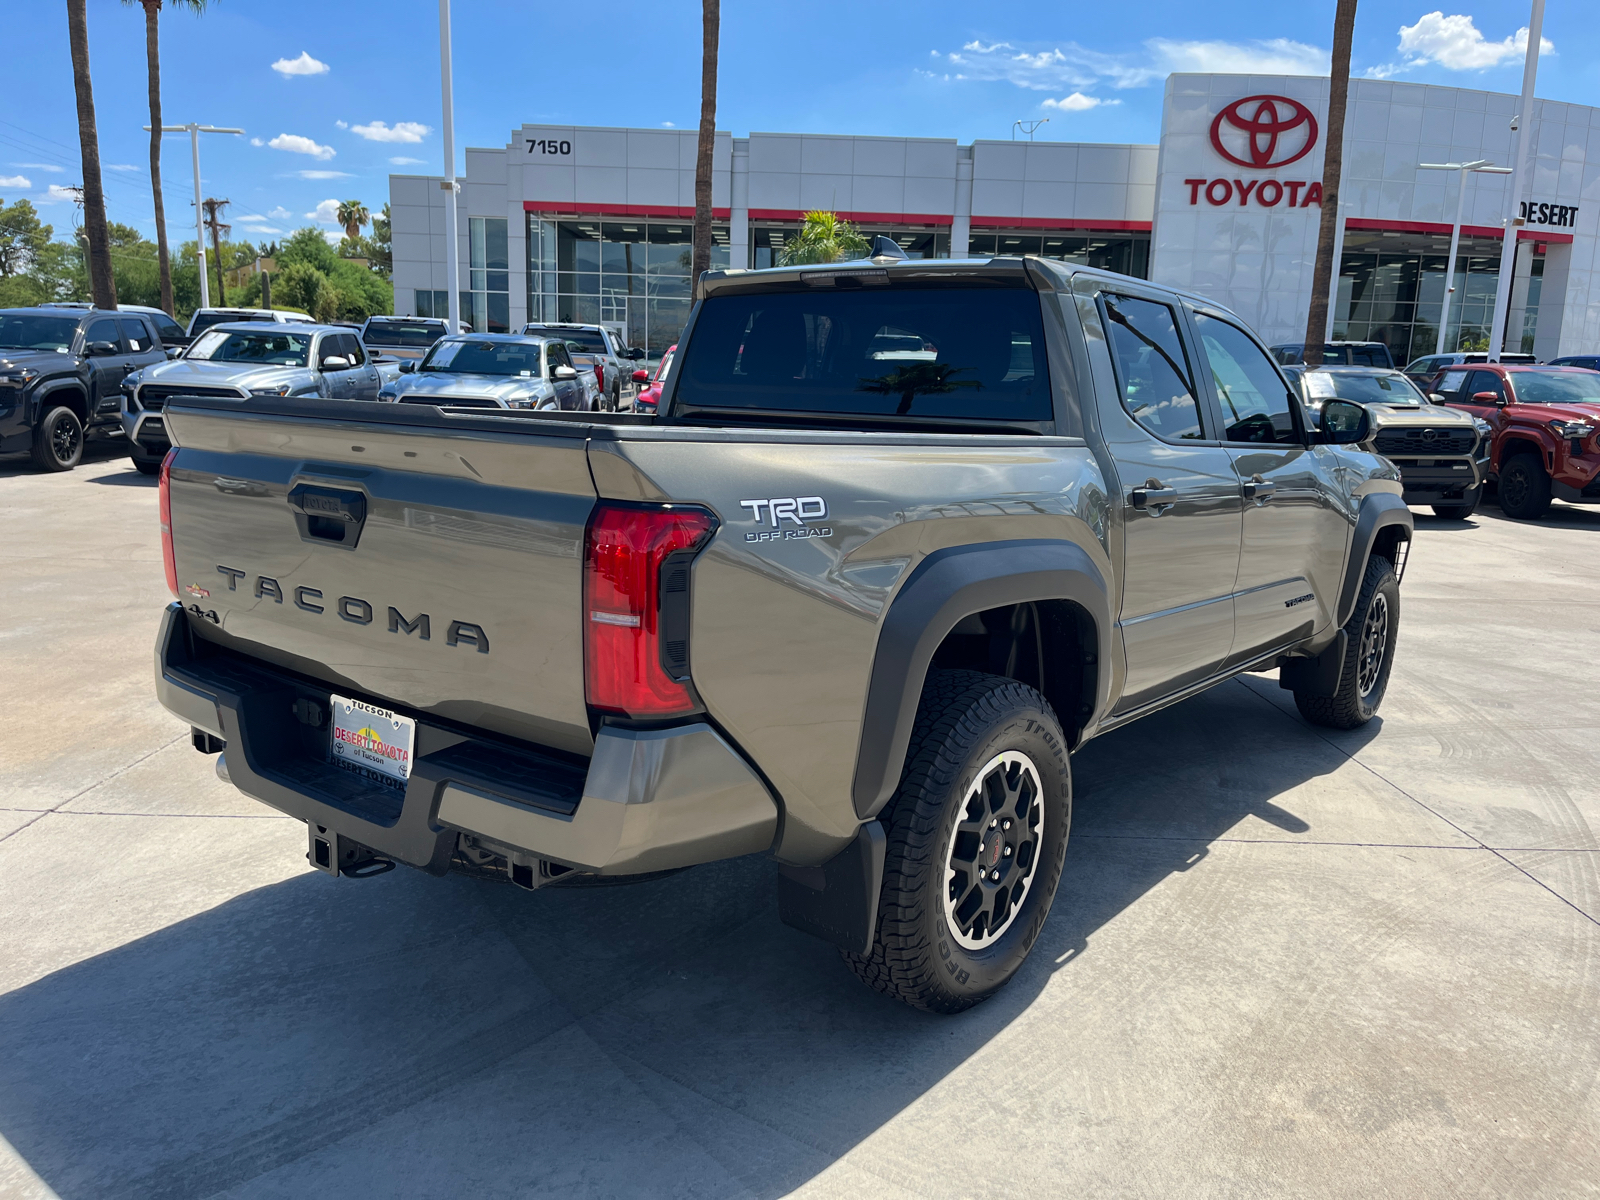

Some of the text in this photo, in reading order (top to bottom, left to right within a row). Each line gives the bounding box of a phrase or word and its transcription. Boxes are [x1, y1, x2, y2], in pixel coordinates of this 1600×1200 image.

[525, 139, 571, 155] 7150
[1184, 178, 1323, 208] TOYOTA
[305, 496, 339, 512] TOYOTA
[739, 495, 829, 530] TRD
[744, 527, 833, 544] OFF ROAD
[216, 564, 490, 655] TACOMA
[352, 701, 392, 719] TUCSON
[335, 727, 409, 763] DESERT TOYOTA
[354, 749, 384, 764] of Tucson
[331, 757, 405, 792] DESERT TOYOTA
